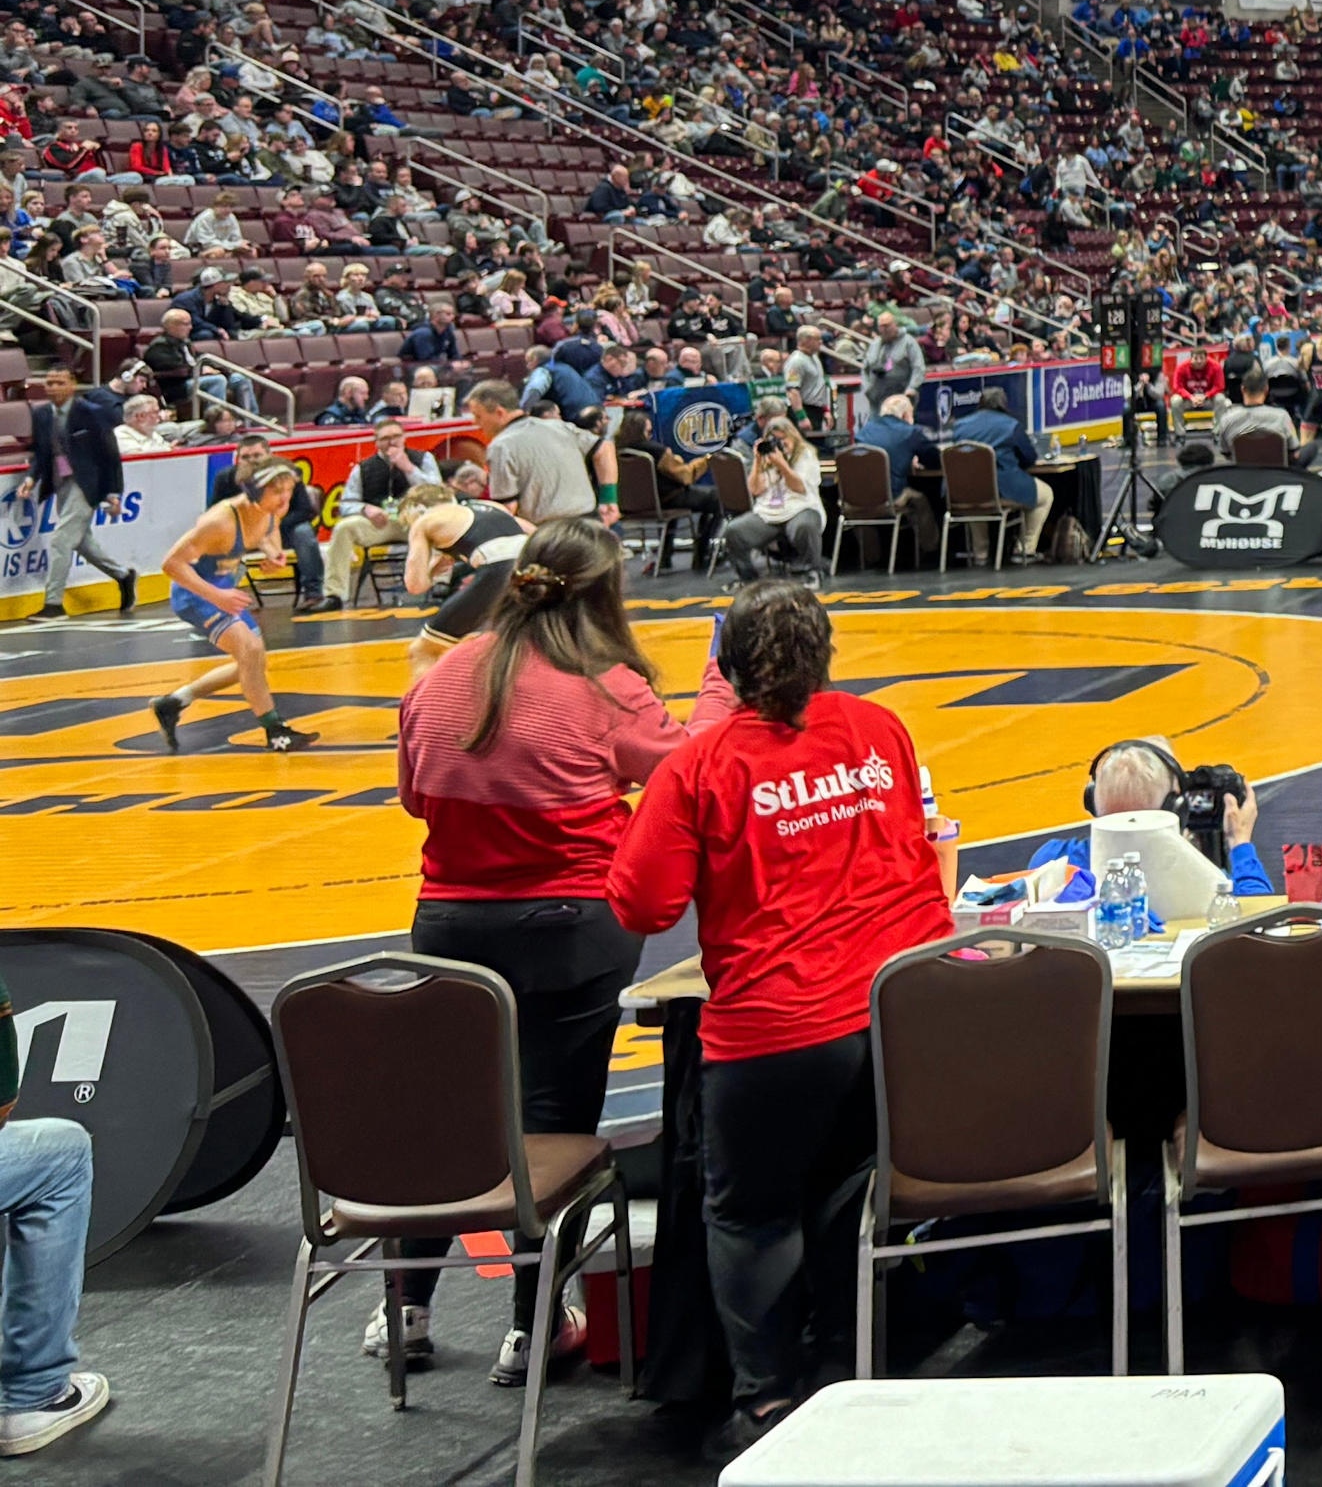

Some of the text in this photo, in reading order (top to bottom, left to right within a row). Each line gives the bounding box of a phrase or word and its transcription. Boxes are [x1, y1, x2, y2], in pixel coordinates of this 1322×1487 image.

[1072, 380, 1105, 408] planet
[4, 553, 22, 576] IS
[776, 811, 830, 837] Sports
